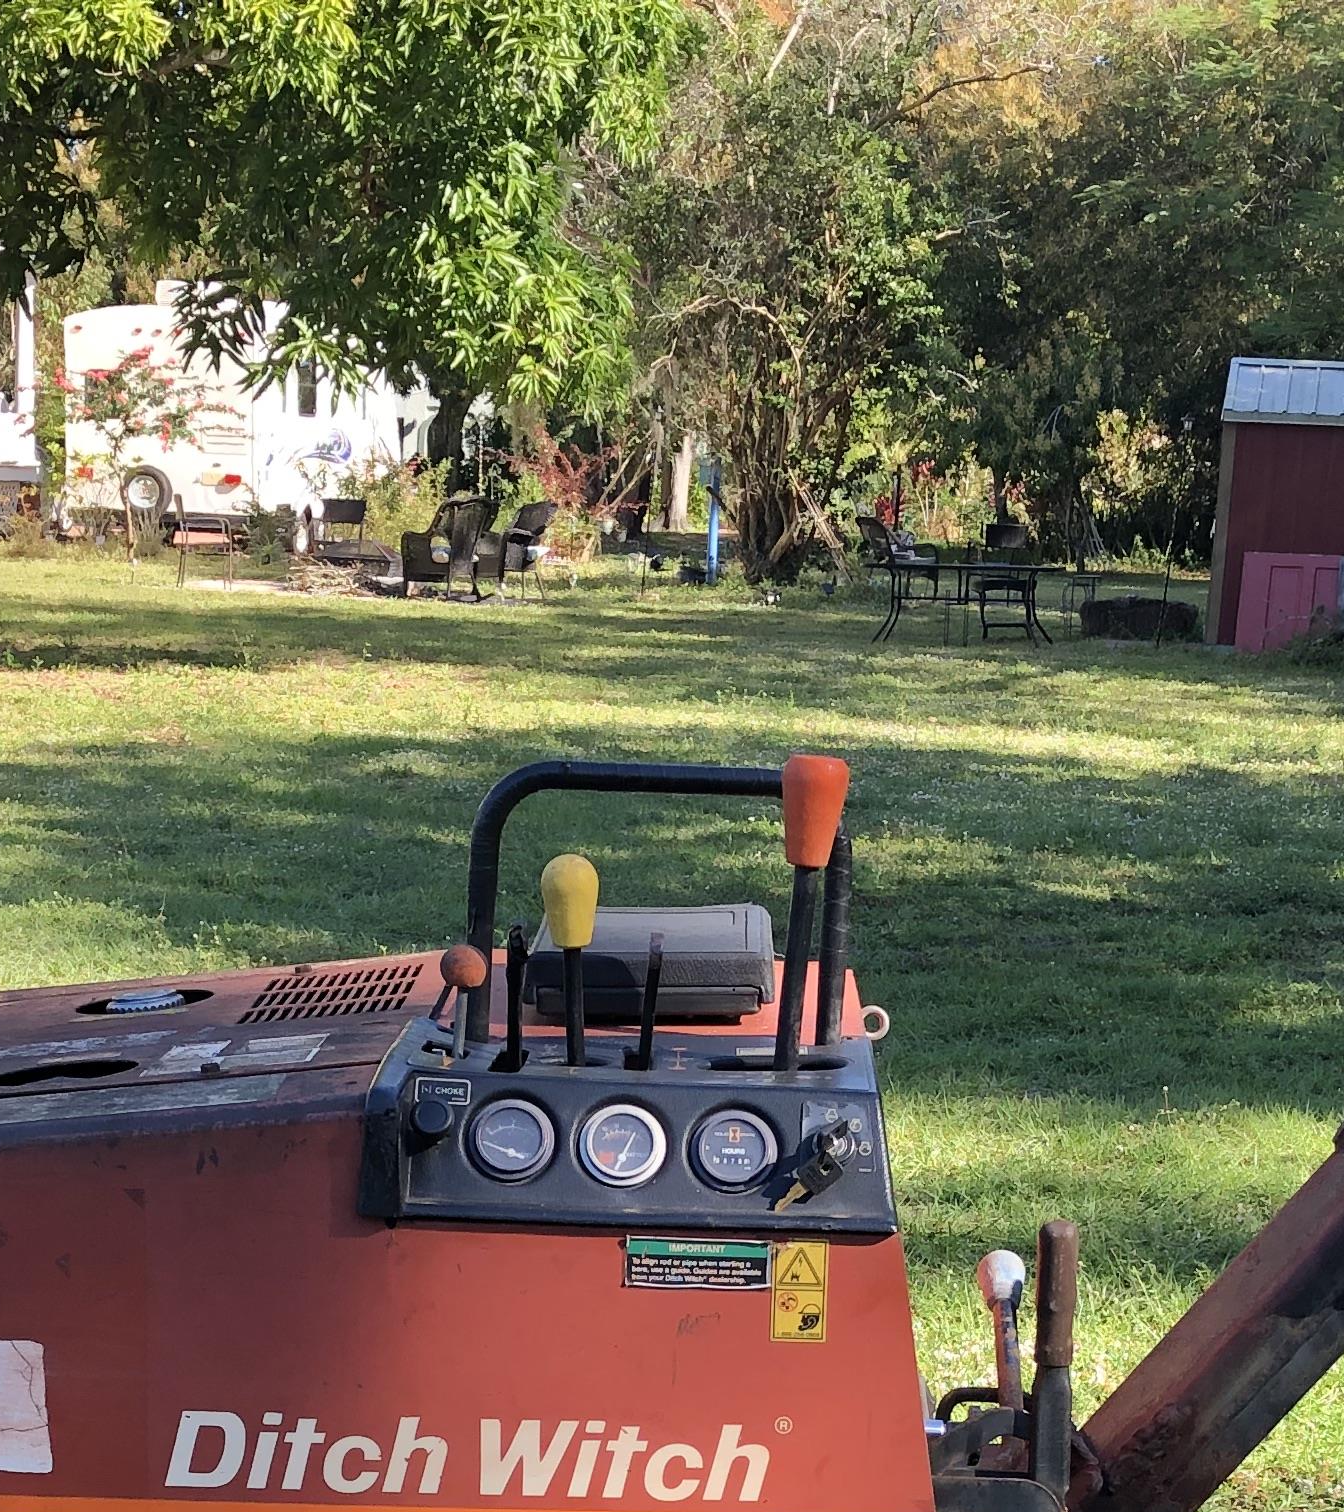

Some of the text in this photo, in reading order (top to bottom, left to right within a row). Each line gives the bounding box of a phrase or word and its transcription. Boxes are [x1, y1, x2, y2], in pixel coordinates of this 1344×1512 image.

[434, 1086, 465, 1096] CHOKE
[721, 1147, 746, 1155] HOURS
[668, 1243, 726, 1254] IMPORTANT
[164, 1409, 449, 1495] Ditch
